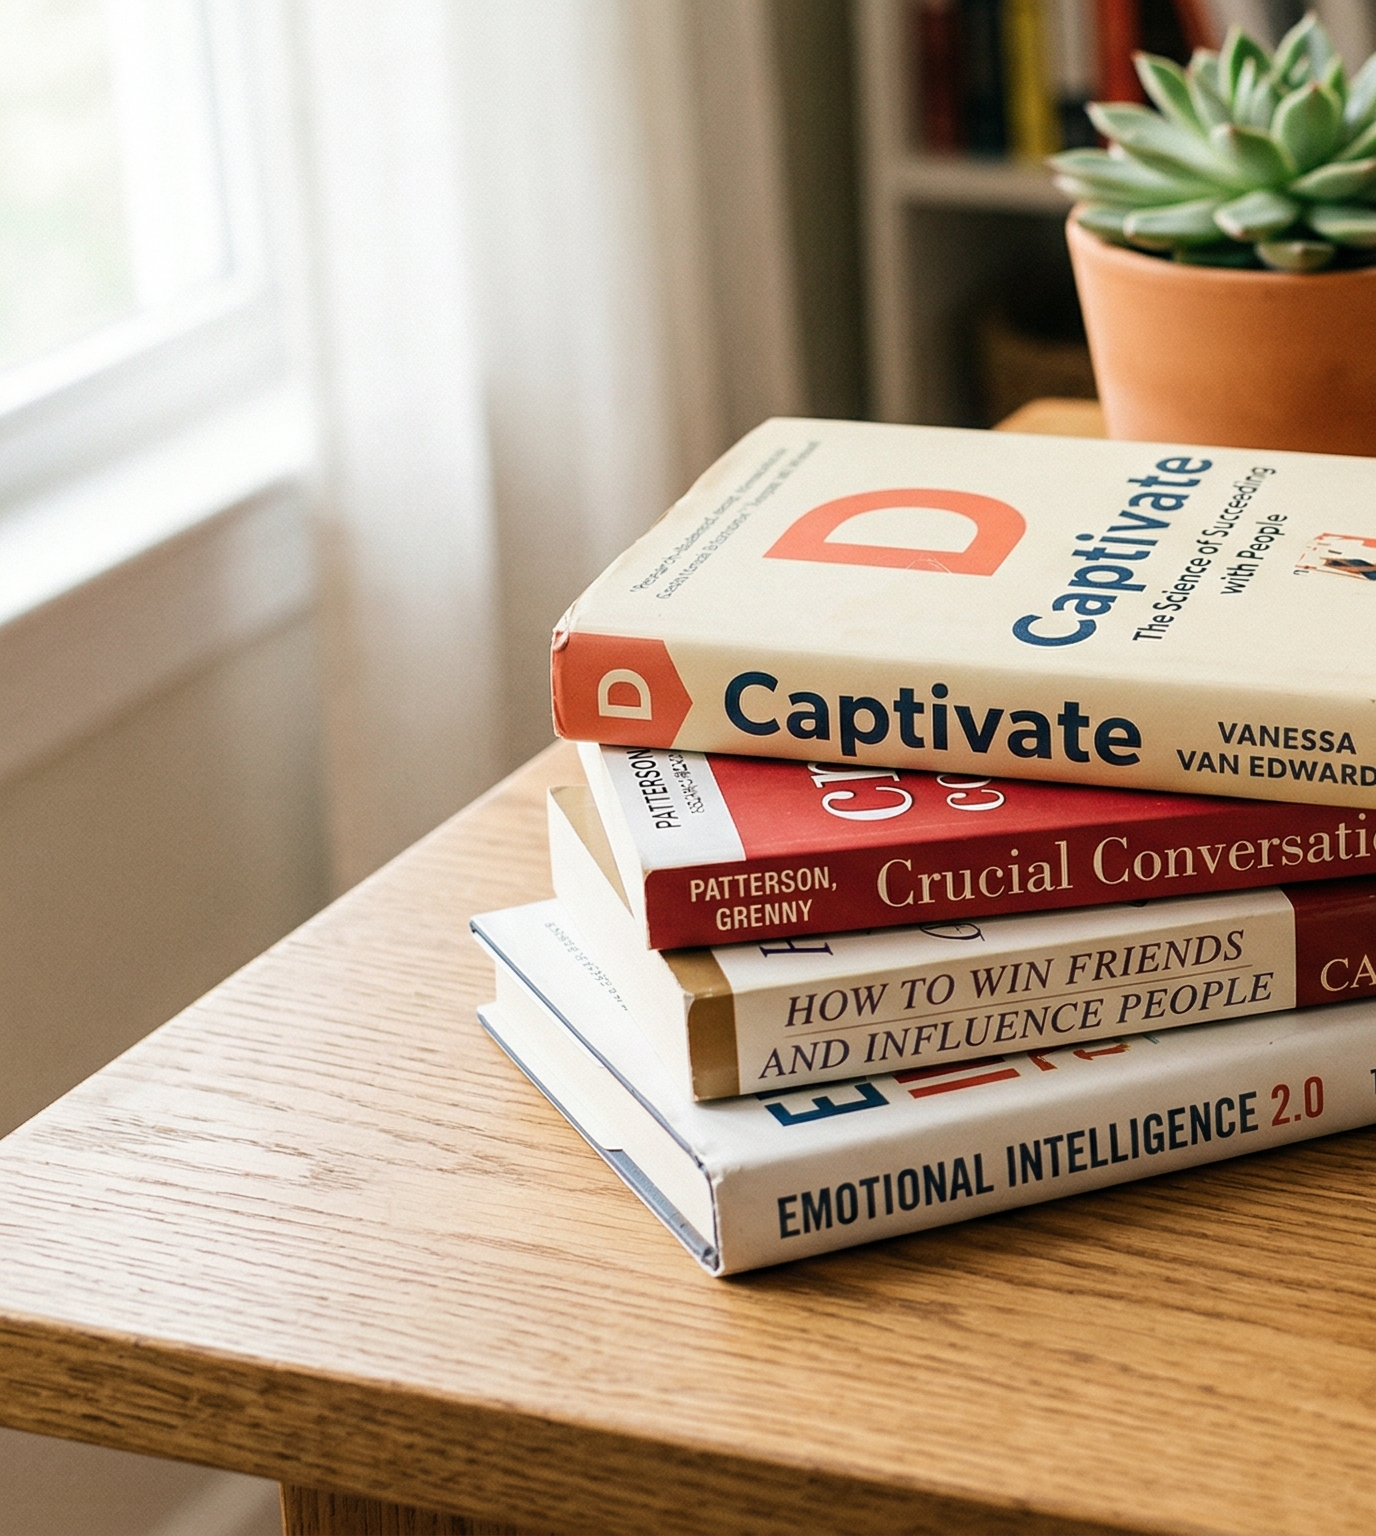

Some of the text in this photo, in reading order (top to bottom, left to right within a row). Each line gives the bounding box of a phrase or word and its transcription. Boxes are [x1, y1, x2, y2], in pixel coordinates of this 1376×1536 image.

[1012, 457, 1213, 647] Captivate
[1132, 467, 1276, 641] The Science of Succeeding
[1220, 514, 1288, 595] with People
[724, 671, 1142, 766] Captivate
[1176, 749, 1240, 775] VAN
[1217, 721, 1357, 755] VANESSA
[690, 866, 837, 902] PATTERSON,
[716, 900, 813, 931] GRENNY
[877, 841, 1073, 907] Crucial
[784, 929, 1245, 1027] HOW TO WIN FRIENDS
[758, 972, 1274, 1079] AND INFLUENCE PEOPLE
[777, 1076, 1325, 1239] EMOTIONAL INTELLIGENCE 2.0
